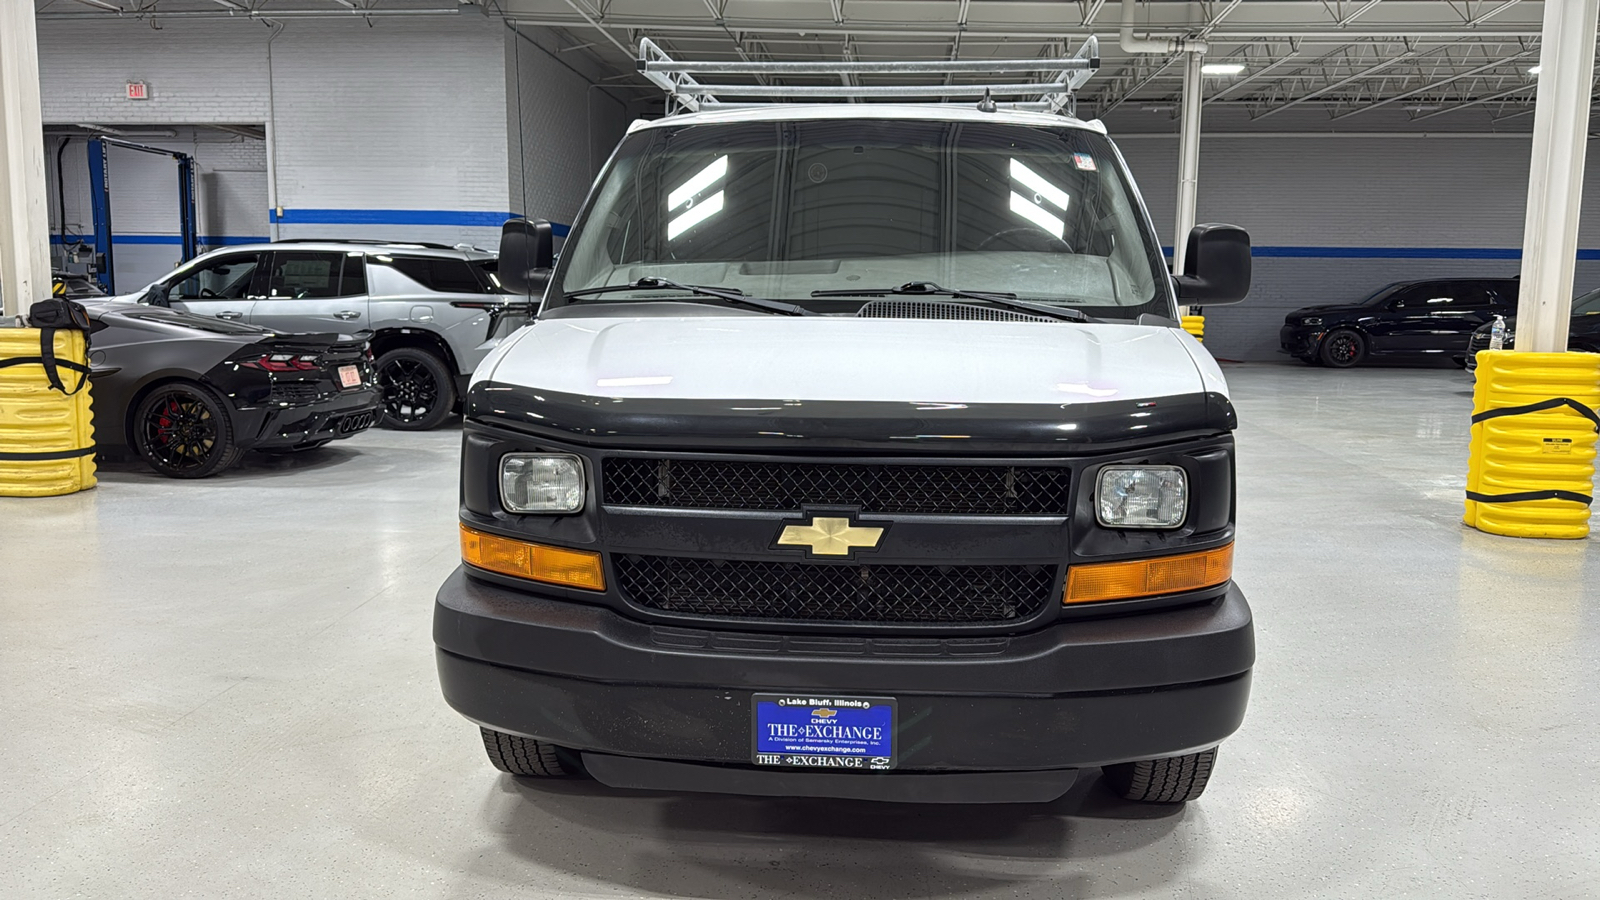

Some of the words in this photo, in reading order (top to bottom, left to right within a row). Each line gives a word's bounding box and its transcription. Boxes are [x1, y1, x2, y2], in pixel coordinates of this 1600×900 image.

[129, 85, 143, 97] EXIT
[809, 698, 832, 706] Bluff,
[834, 699, 862, 707] Illinois
[767, 723, 798, 737] THE
[805, 725, 882, 740] EXCHANGE
[785, 745, 866, 753] www.chevyexchange.com
[757, 755, 781, 765] THE
[793, 756, 863, 768] EXCHANGE
